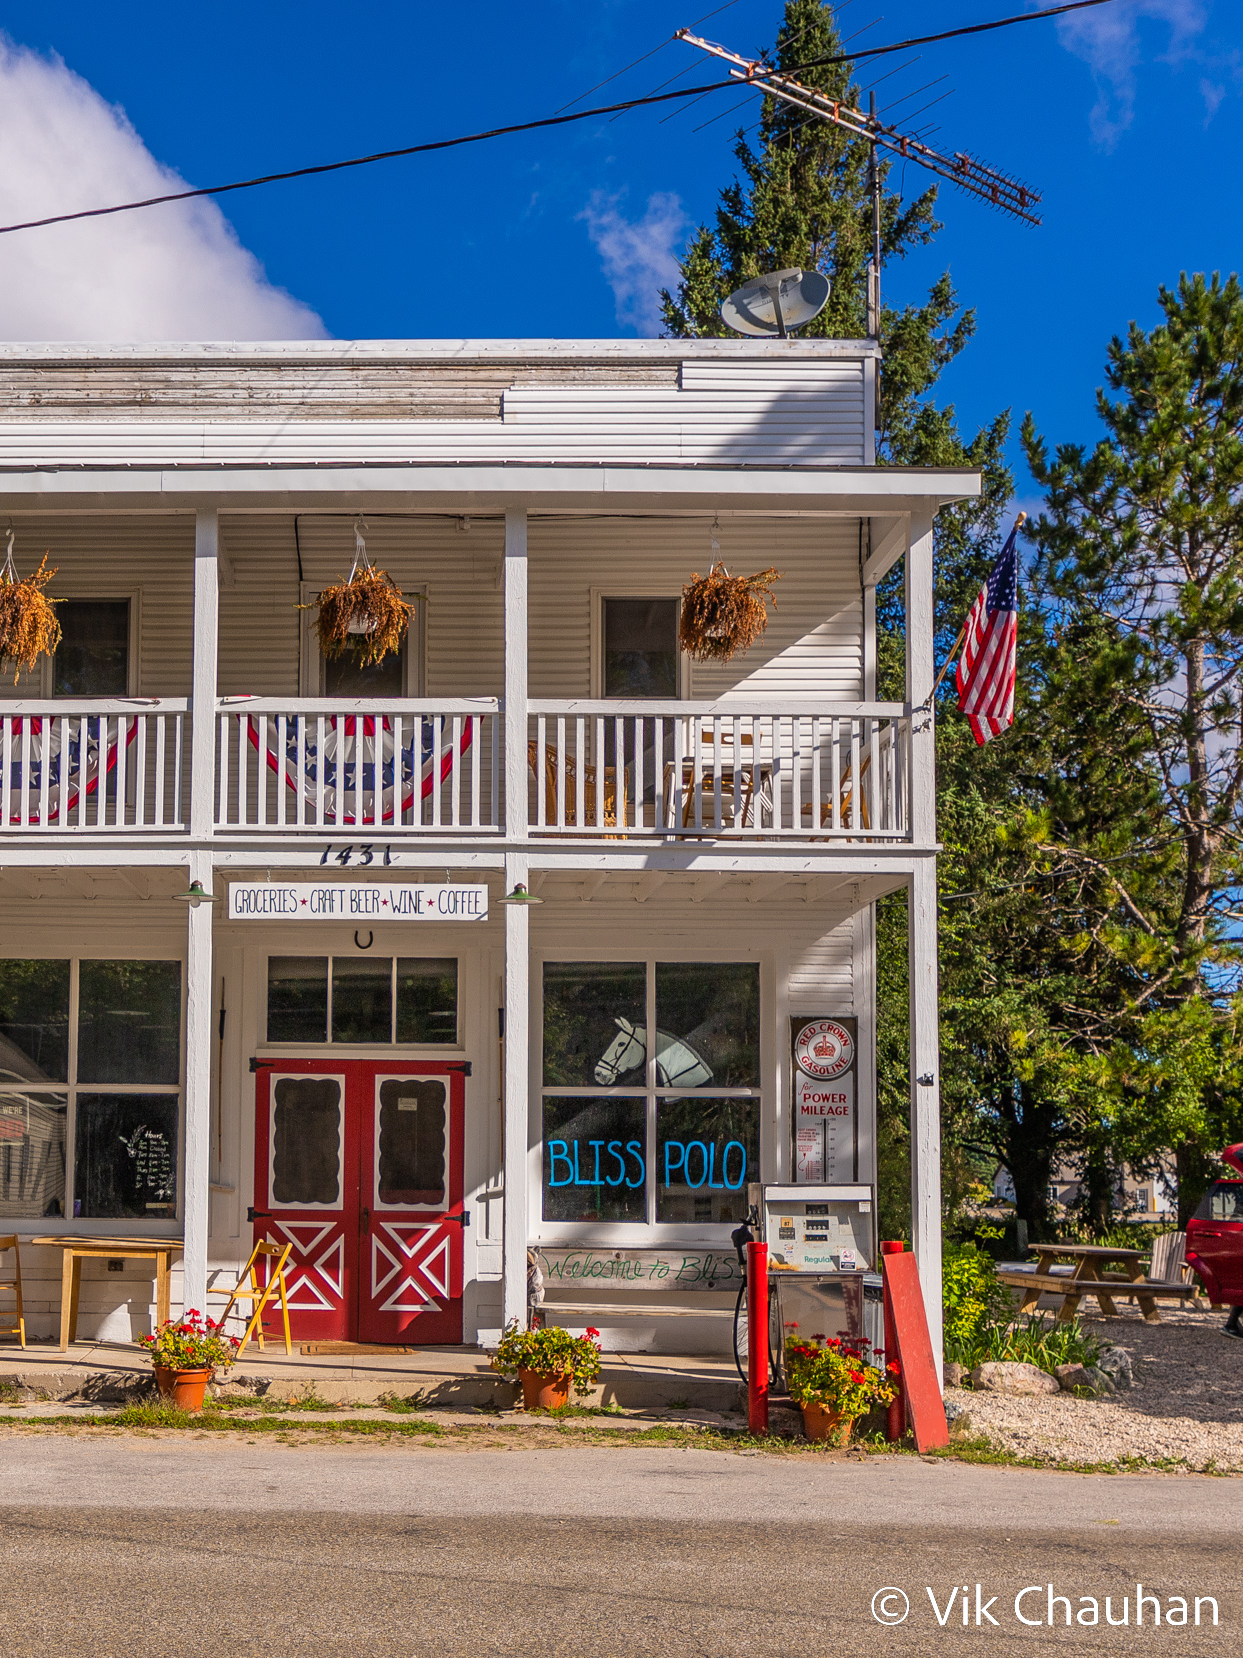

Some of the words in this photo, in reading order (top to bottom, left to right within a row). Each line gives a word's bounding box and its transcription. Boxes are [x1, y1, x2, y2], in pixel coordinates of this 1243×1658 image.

[319, 844, 392, 866] 1431
[234, 889, 298, 914] GROCERIES
[310, 889, 346, 914] CRAFT
[350, 889, 380, 913] BEER
[390, 890, 425, 914] WINE
[438, 890, 483, 915] COFFEE
[799, 1026, 817, 1046] RED
[819, 1023, 851, 1047] CROWN
[801, 1055, 849, 1075] GASOLINE
[798, 1081, 814, 1096] for
[803, 1093, 847, 1104] POWER
[2, 1106, 23, 1115] WE'RE
[801, 1105, 849, 1116] MILEAGE
[144, 1130, 163, 1139] Hours
[547, 1140, 646, 1189] BLISS
[665, 1140, 747, 1190] POLO
[540, 1251, 645, 1281] Welcome
[648, 1259, 670, 1280] to
[804, 1255, 832, 1264] Regular
